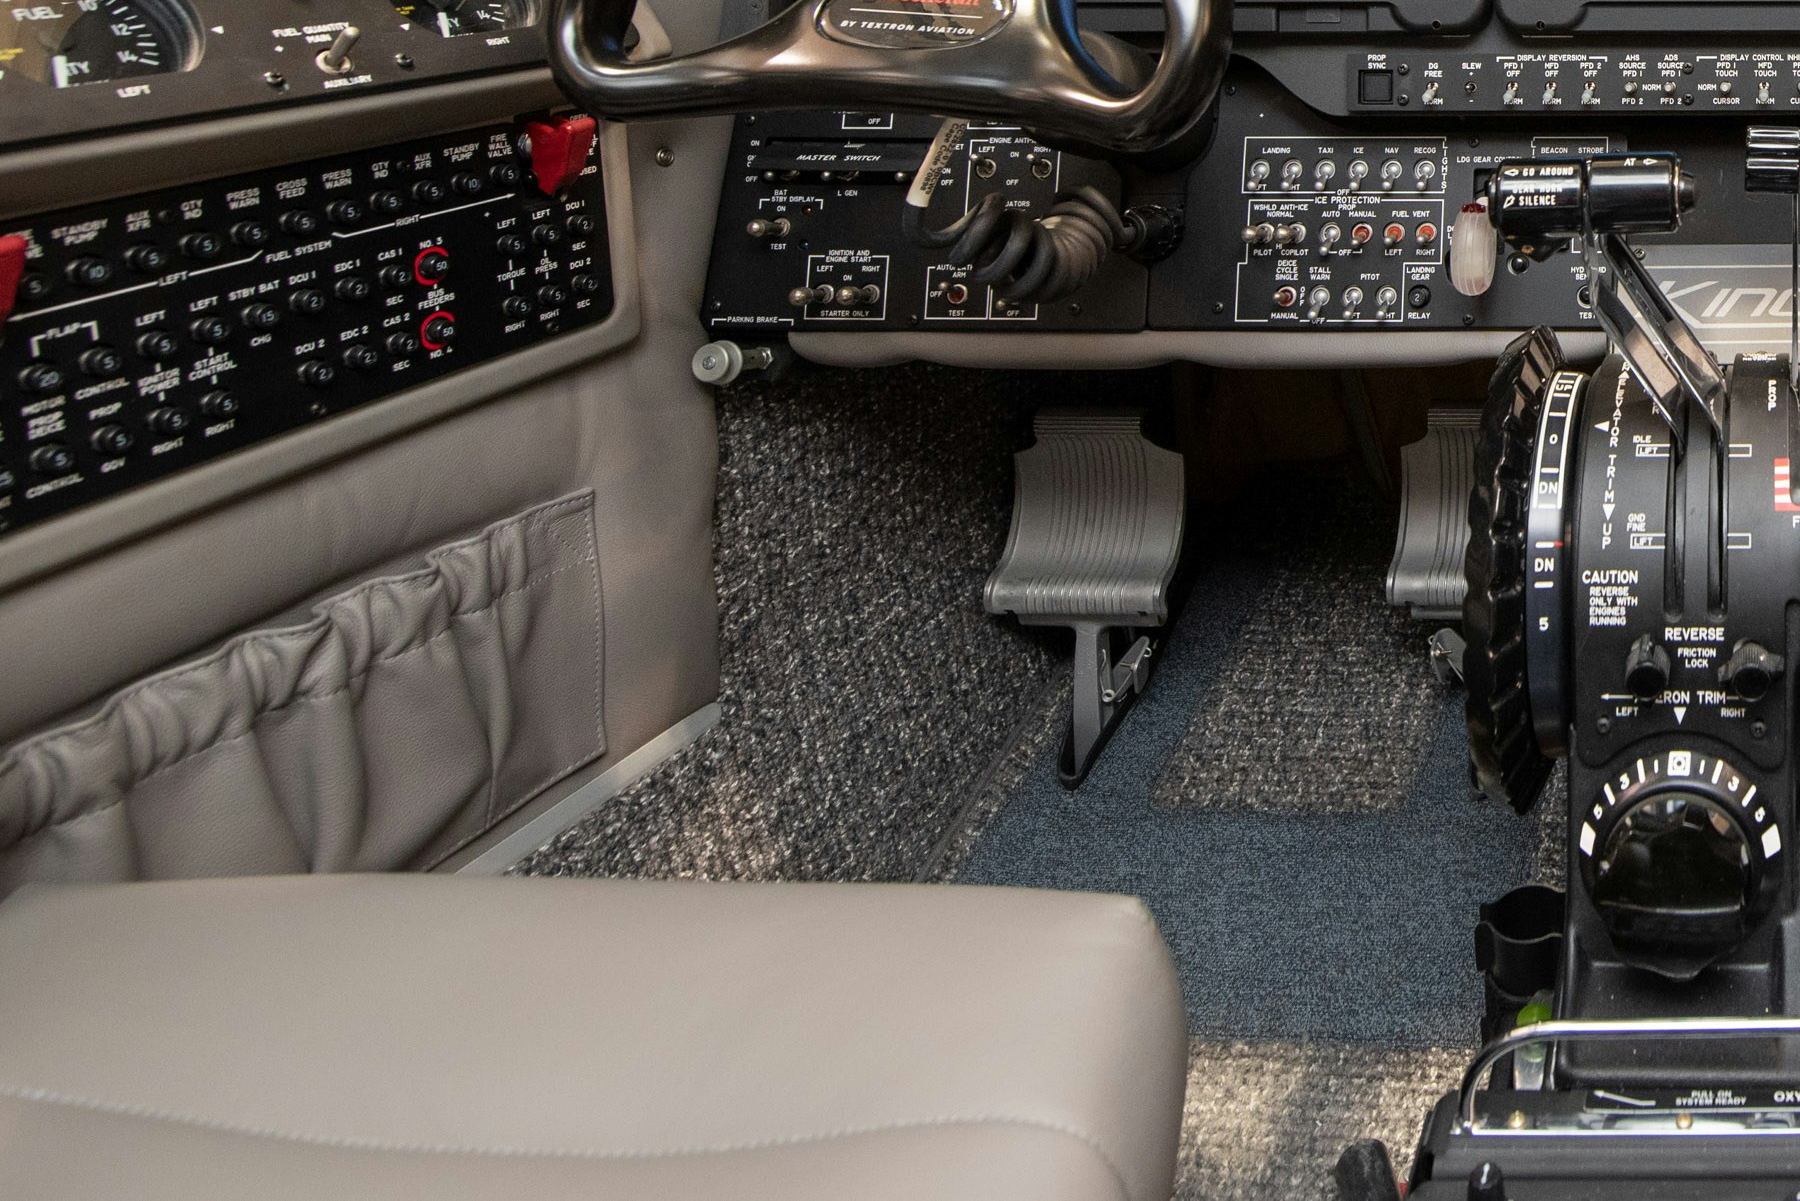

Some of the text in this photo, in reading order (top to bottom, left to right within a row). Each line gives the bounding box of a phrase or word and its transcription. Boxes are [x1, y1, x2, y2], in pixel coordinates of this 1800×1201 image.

[860, 22, 915, 30] TEXTRON
[917, 26, 975, 35] AVIATION
[443, 143, 479, 157] STANDBY
[452, 152, 473, 162] PUMP
[844, 154, 881, 162] SWITCH
[1624, 158, 1636, 166] AT
[1522, 167, 1573, 176] GO AROUND
[1519, 196, 1556, 205] SILENCE
[266, 239, 332, 263] FUEL SYSTEM
[497, 268, 526, 283] TORQUE
[1538, 481, 1558, 495] DN
[1582, 570, 1638, 584] CAUTION
[1589, 587, 1629, 595] REVERSE
[1589, 597, 1638, 606] ONLY WITH
[1589, 607, 1626, 616] ENGINES
[1589, 617, 1626, 626] RUNNING
[1664, 627, 1724, 641] REVERSE
[1677, 648, 1716, 657] FRICTION
[1685, 659, 1708, 668] LOCK
